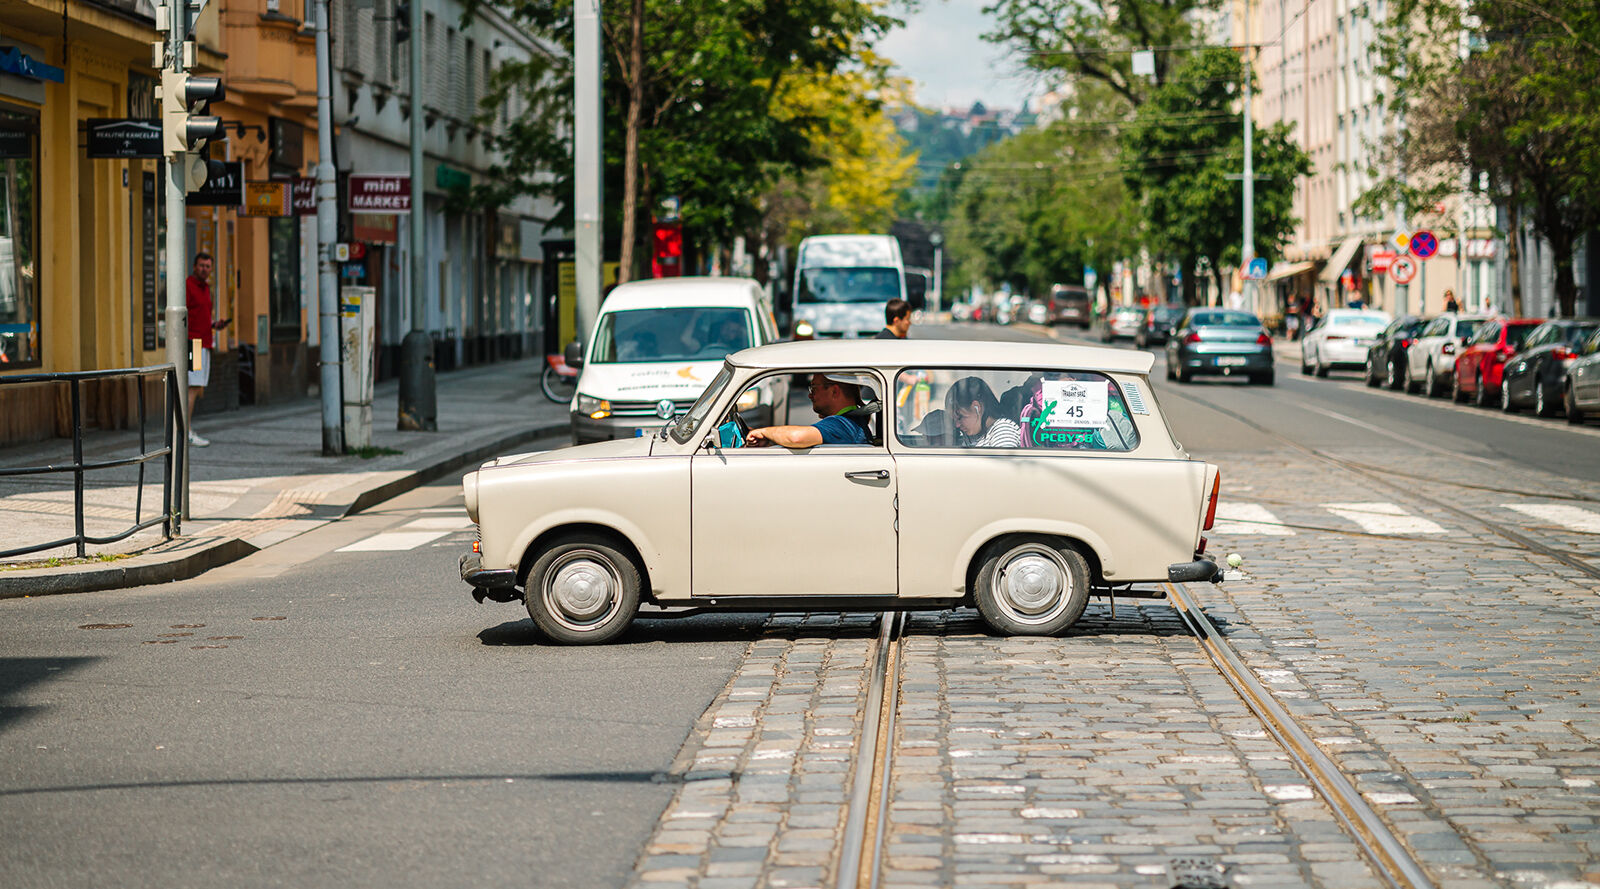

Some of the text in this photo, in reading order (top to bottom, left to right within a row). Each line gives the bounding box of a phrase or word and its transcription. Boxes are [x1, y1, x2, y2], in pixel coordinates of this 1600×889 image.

[363, 178, 401, 192] mini
[353, 195, 409, 208] MARKET
[1067, 405, 1083, 417] 45
